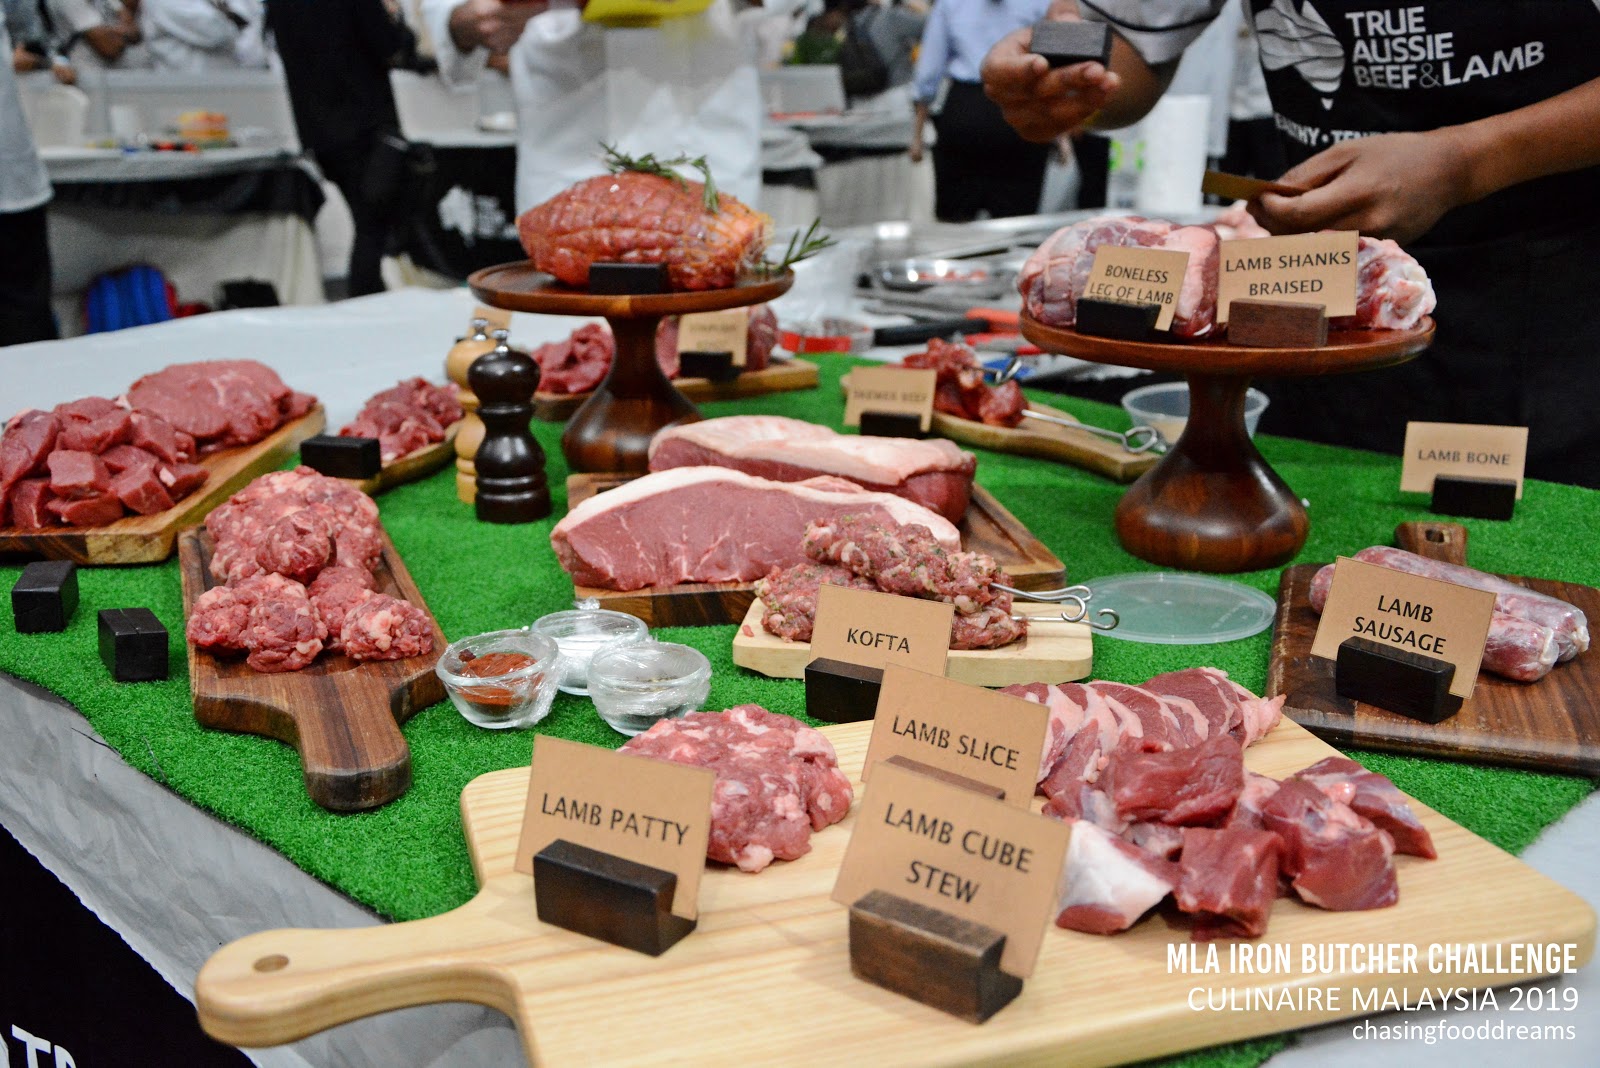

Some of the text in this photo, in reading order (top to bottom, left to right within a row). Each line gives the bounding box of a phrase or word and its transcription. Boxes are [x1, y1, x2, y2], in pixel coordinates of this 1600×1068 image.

[1345, 6, 1426, 37] TRUE
[1352, 32, 1455, 64] AUSSIE
[1105, 264, 1169, 284] BONELESS
[1225, 250, 1351, 272] LAMB SHANKS
[1089, 282, 1174, 305] LEG OF LAMB
[1249, 279, 1323, 296] BRAISED
[1418, 449, 1511, 466] LAMB BONE
[1377, 594, 1434, 624] LAMB
[846, 627, 910, 654] KOFTA
[1352, 616, 1447, 655] SAUSAGE
[891, 714, 1020, 771] LAMB SLICE
[541, 792, 690, 846] LAMB PATTY
[884, 802, 1034, 874] LAMB CUBE
[905, 860, 981, 904] STEW
